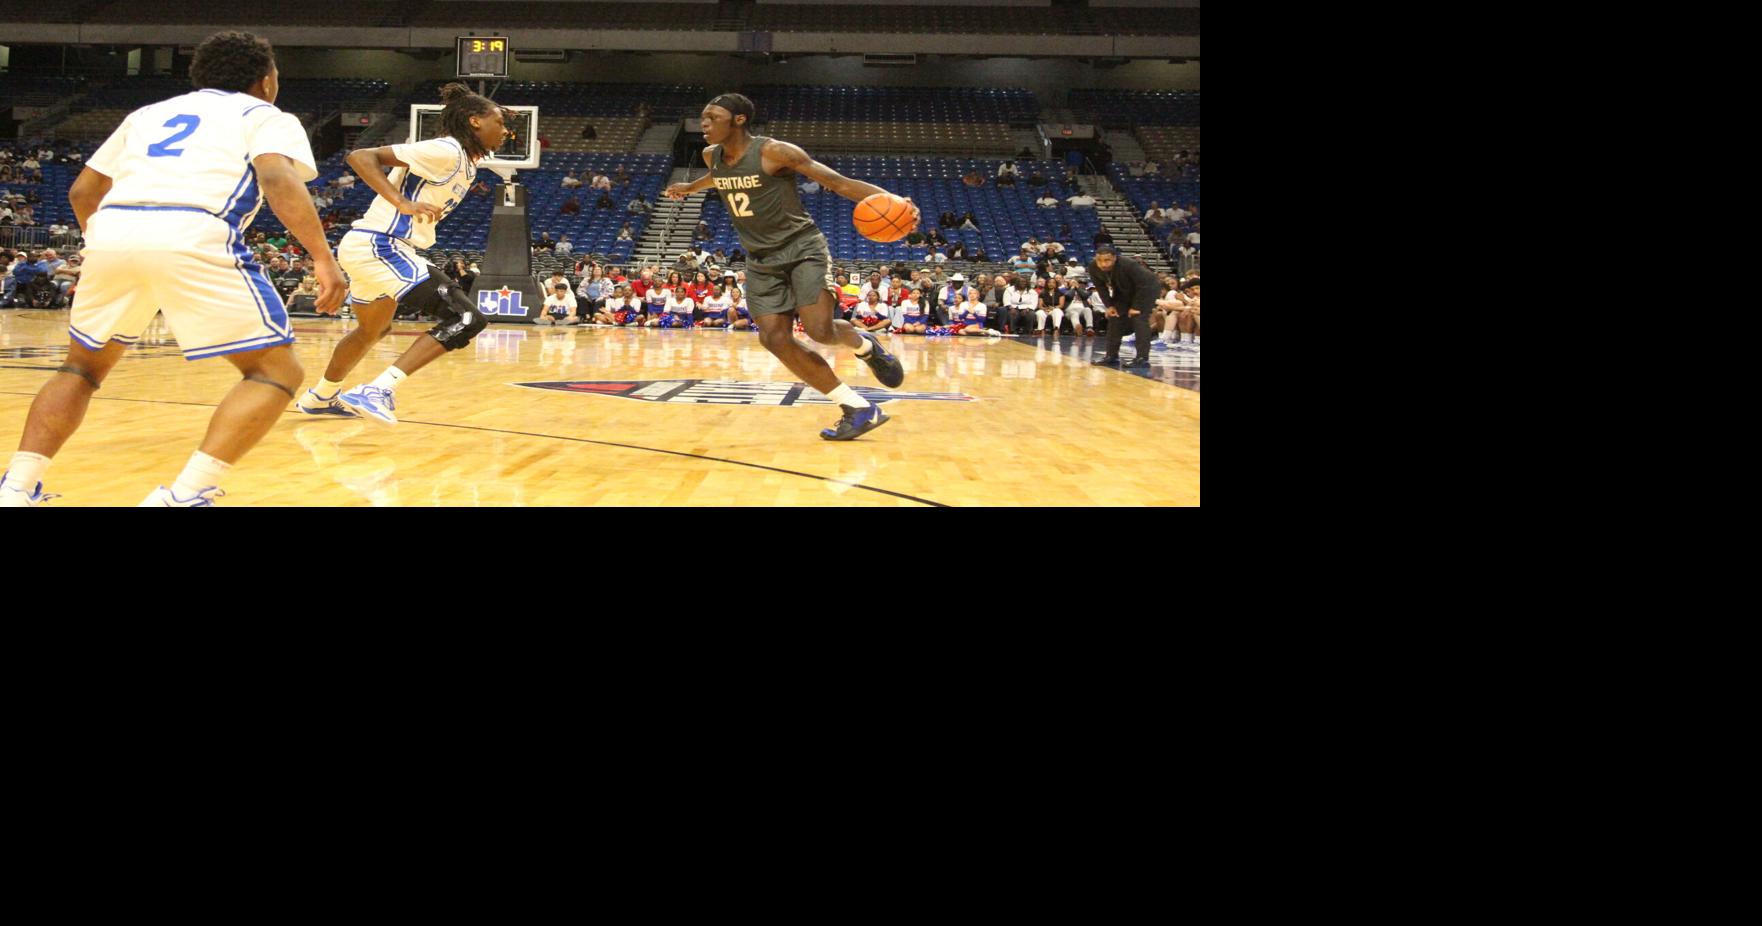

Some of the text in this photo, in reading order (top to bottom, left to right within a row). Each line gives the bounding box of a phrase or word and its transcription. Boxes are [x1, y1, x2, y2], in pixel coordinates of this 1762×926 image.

[473, 40, 504, 52] 3:19
[147, 114, 201, 157] 2
[727, 192, 754, 217] 12
